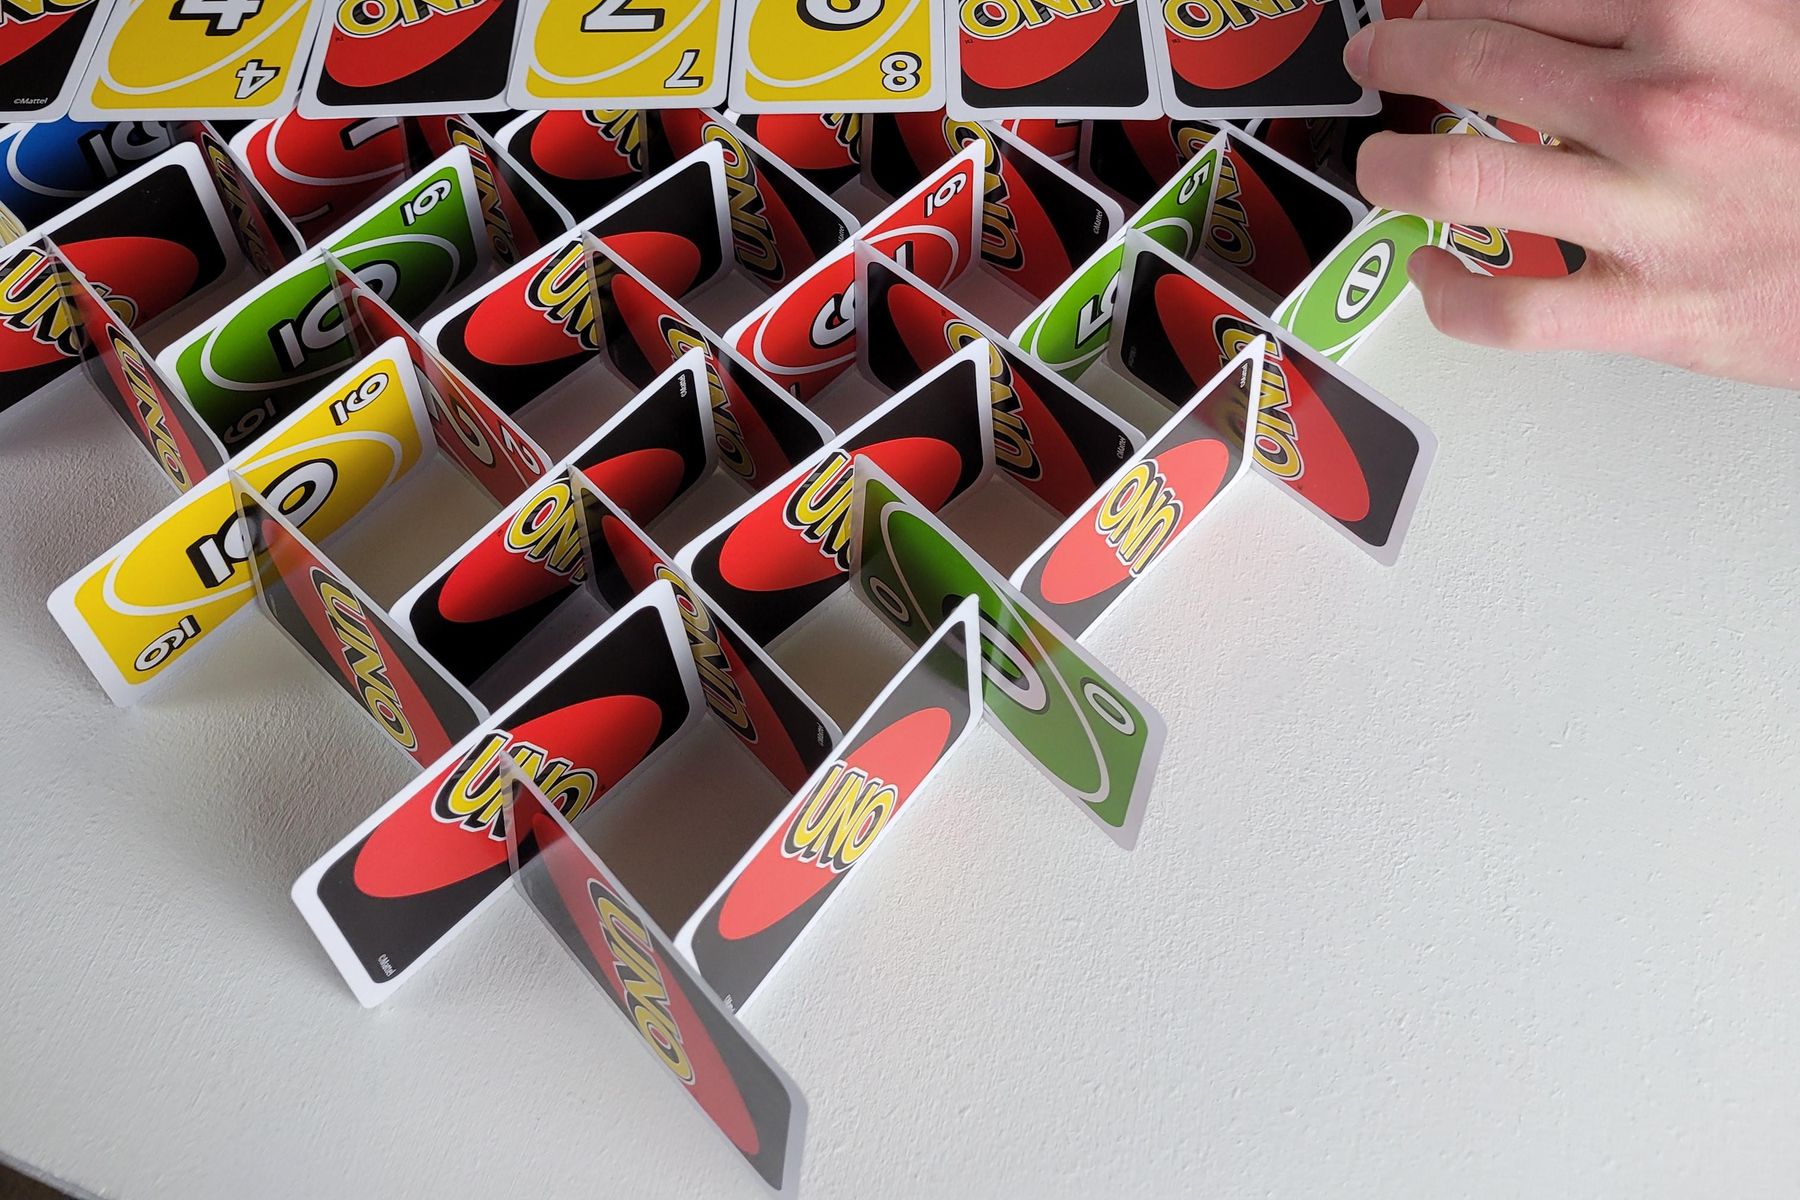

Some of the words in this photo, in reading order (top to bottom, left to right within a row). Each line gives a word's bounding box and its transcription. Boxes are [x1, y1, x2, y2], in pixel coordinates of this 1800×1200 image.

[234, 59, 281, 100] 4
[663, 48, 704, 89] 7
[879, 51, 922, 93] 8
[1177, 160, 1212, 206] 5
[1334, 238, 1396, 324] 0
[1095, 458, 1184, 579] UNO
[308, 565, 420, 755] UNO
[780, 759, 899, 873] UNO
[585, 877, 697, 1086] UNO
